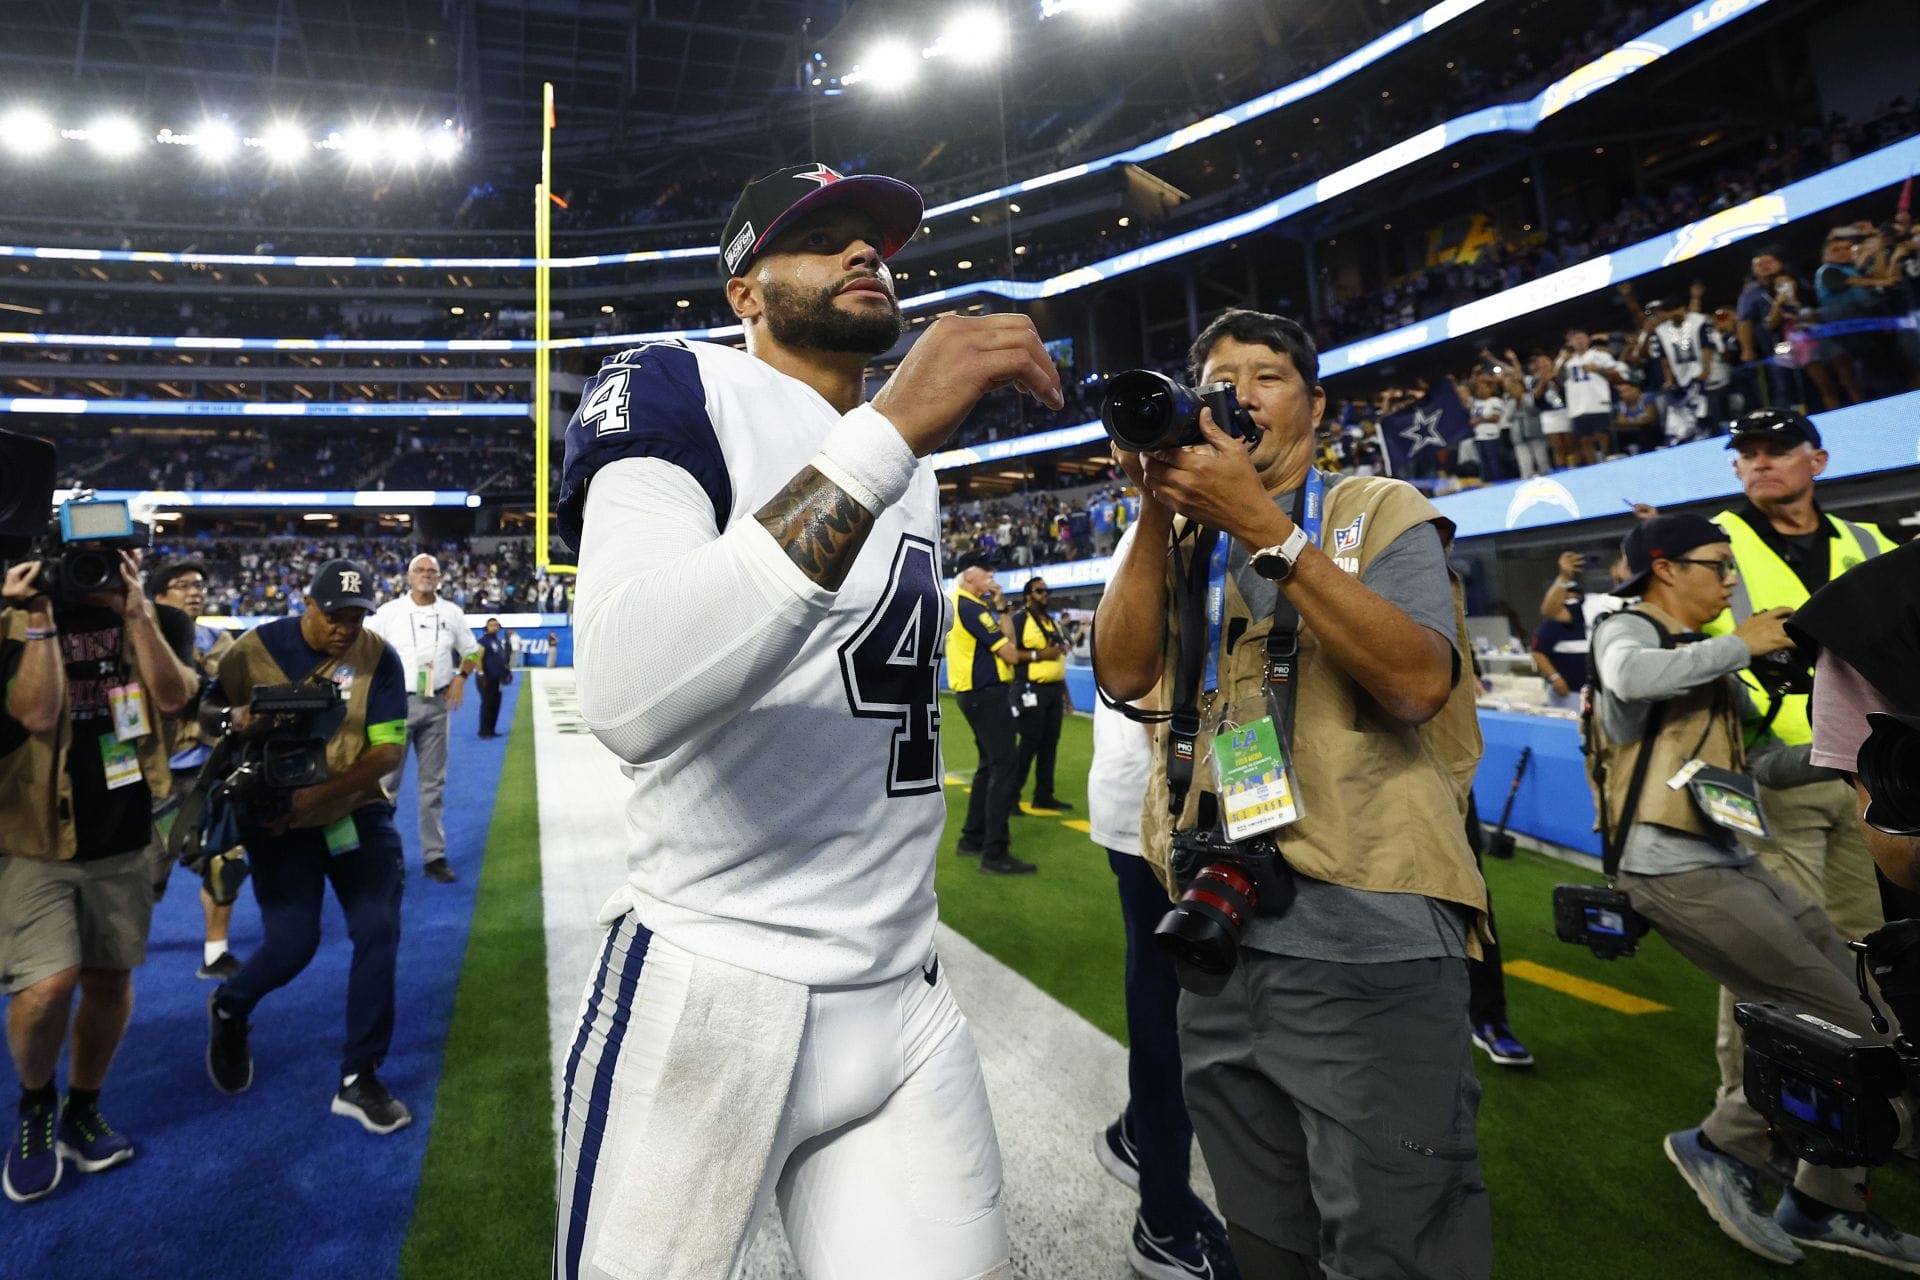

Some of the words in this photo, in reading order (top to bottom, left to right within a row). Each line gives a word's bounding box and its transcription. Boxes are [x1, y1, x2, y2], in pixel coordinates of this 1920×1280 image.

[580, 368, 631, 437] 4
[838, 532, 943, 798] 4
[1274, 666, 1290, 674] PRO
[1177, 742, 1193, 752] PRO
[1232, 729, 1258, 749] LA
